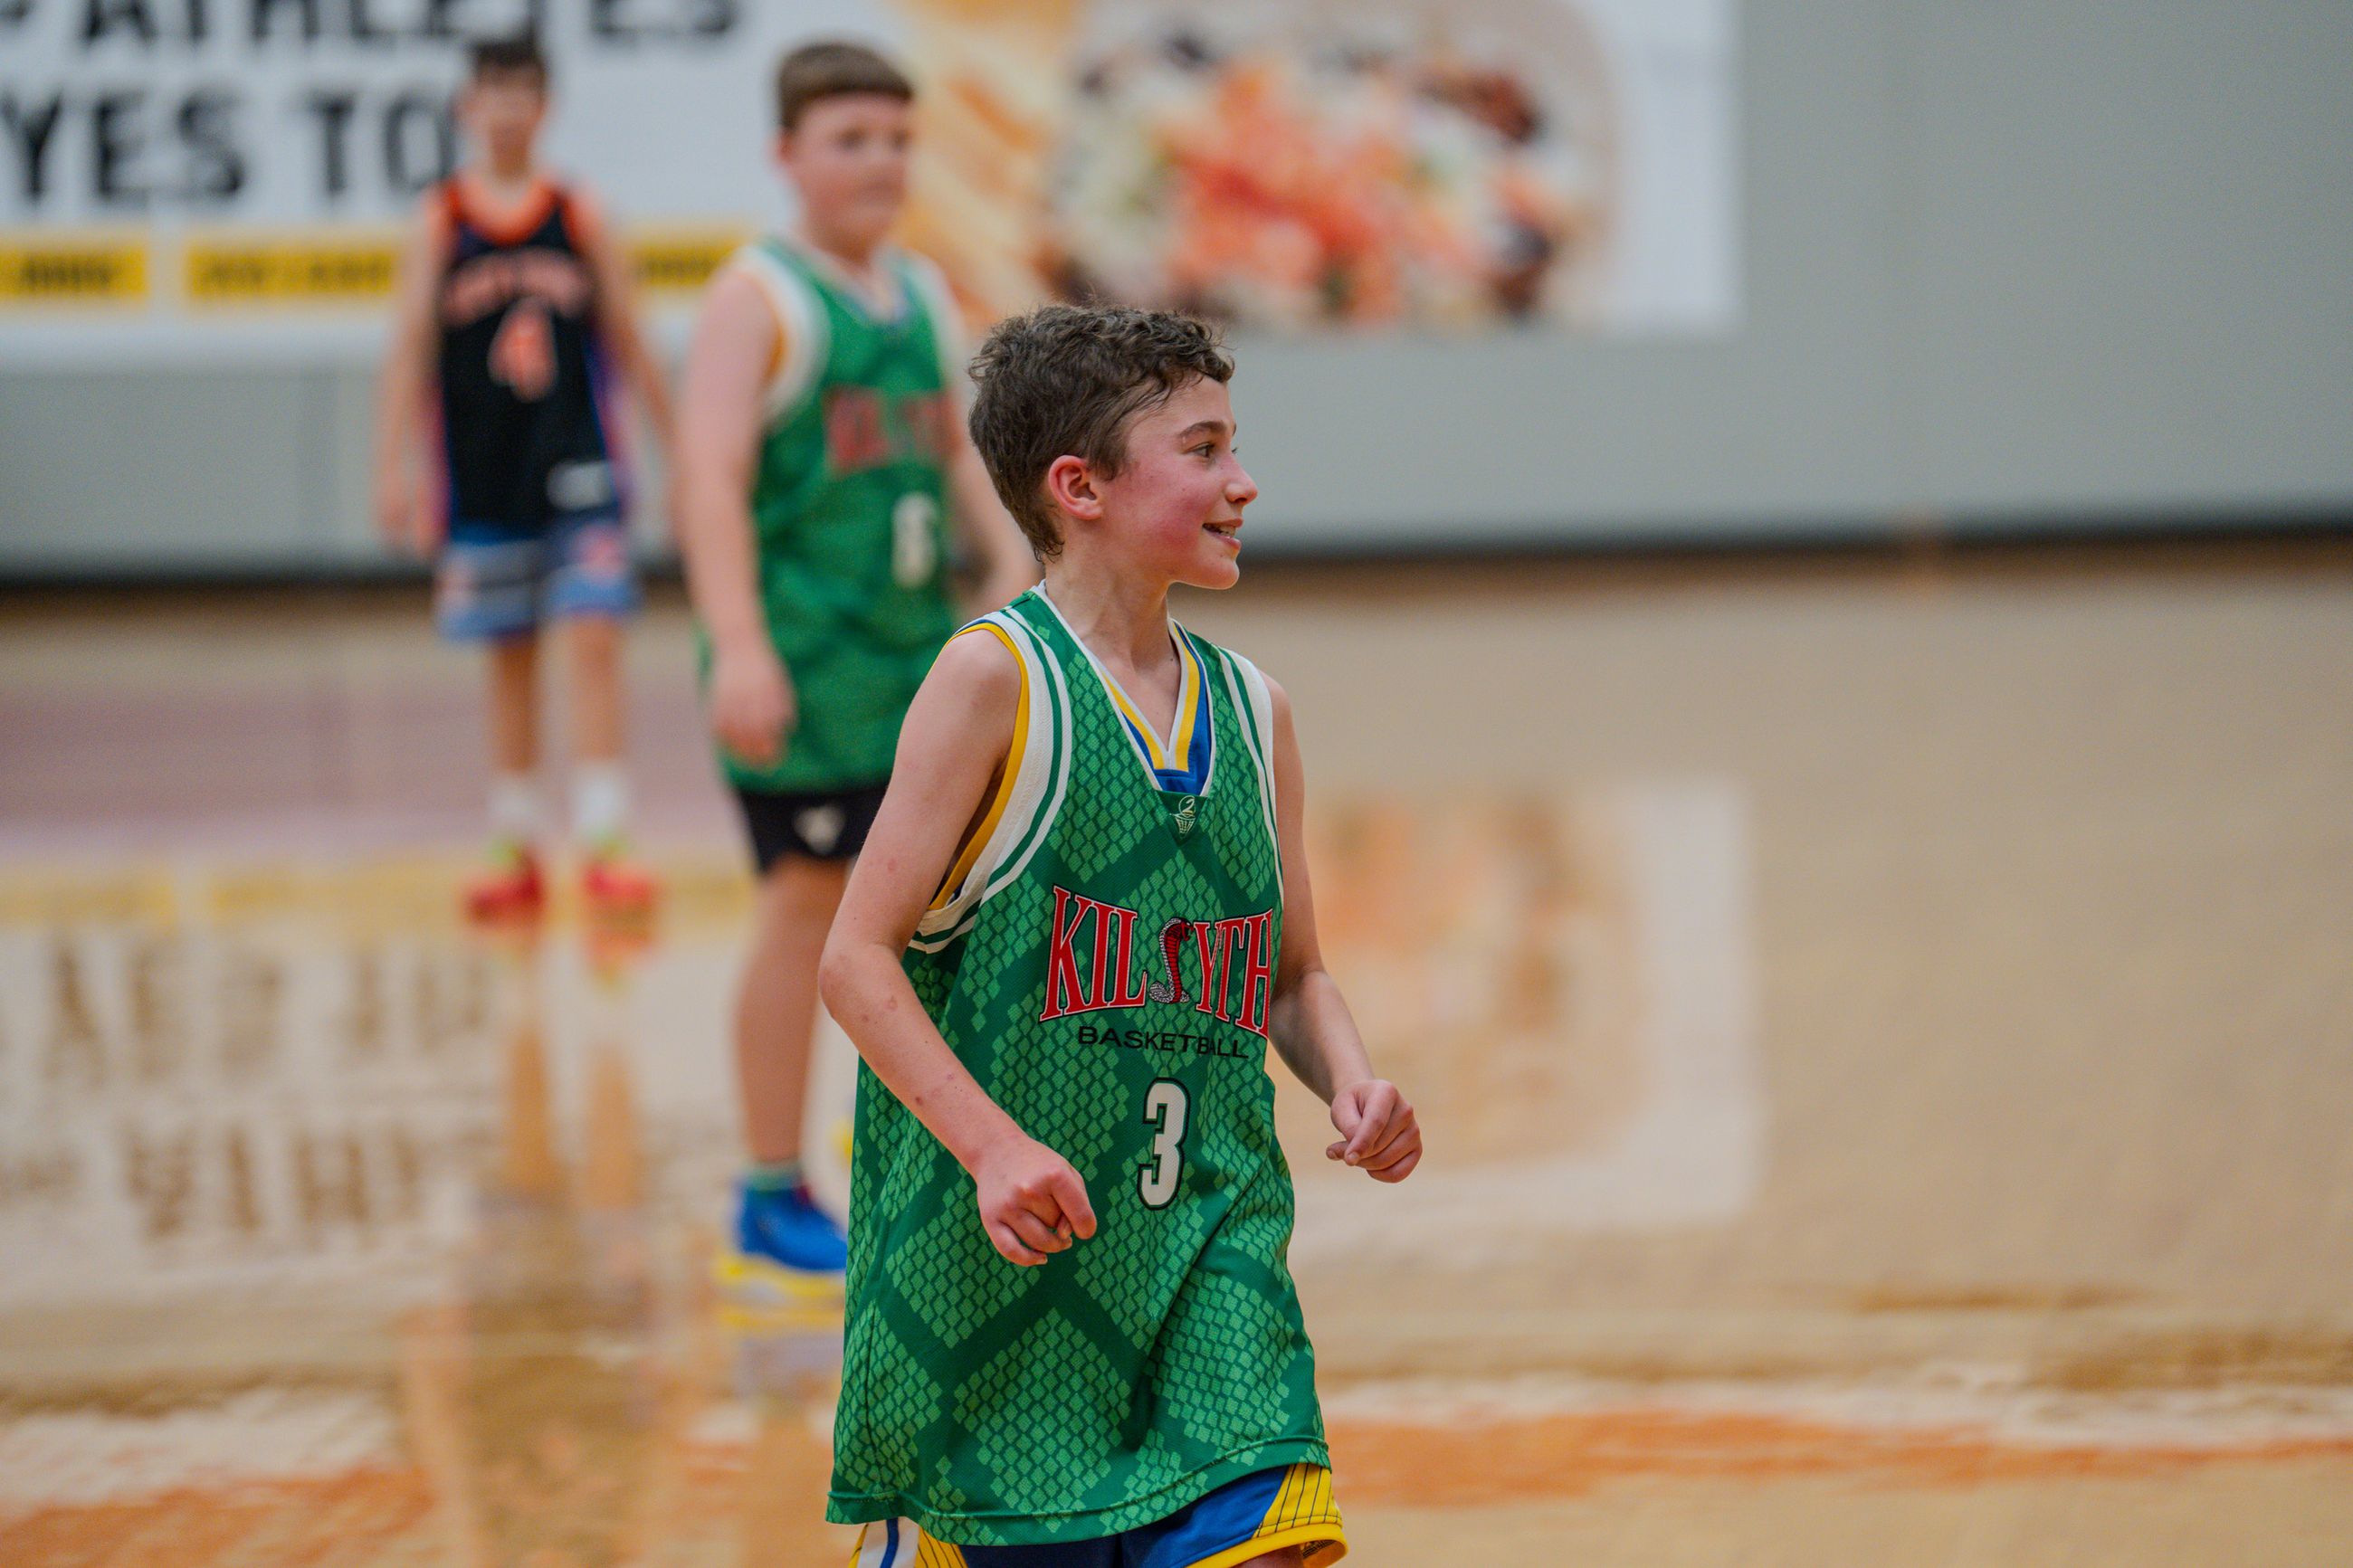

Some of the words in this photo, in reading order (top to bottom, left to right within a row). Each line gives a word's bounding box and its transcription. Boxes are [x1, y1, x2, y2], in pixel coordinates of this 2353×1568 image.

[0, 89, 248, 204] YES
[306, 89, 460, 199] TO
[1077, 1024, 1250, 1060] BASKETBALL
[1137, 1077, 1192, 1212] 3
